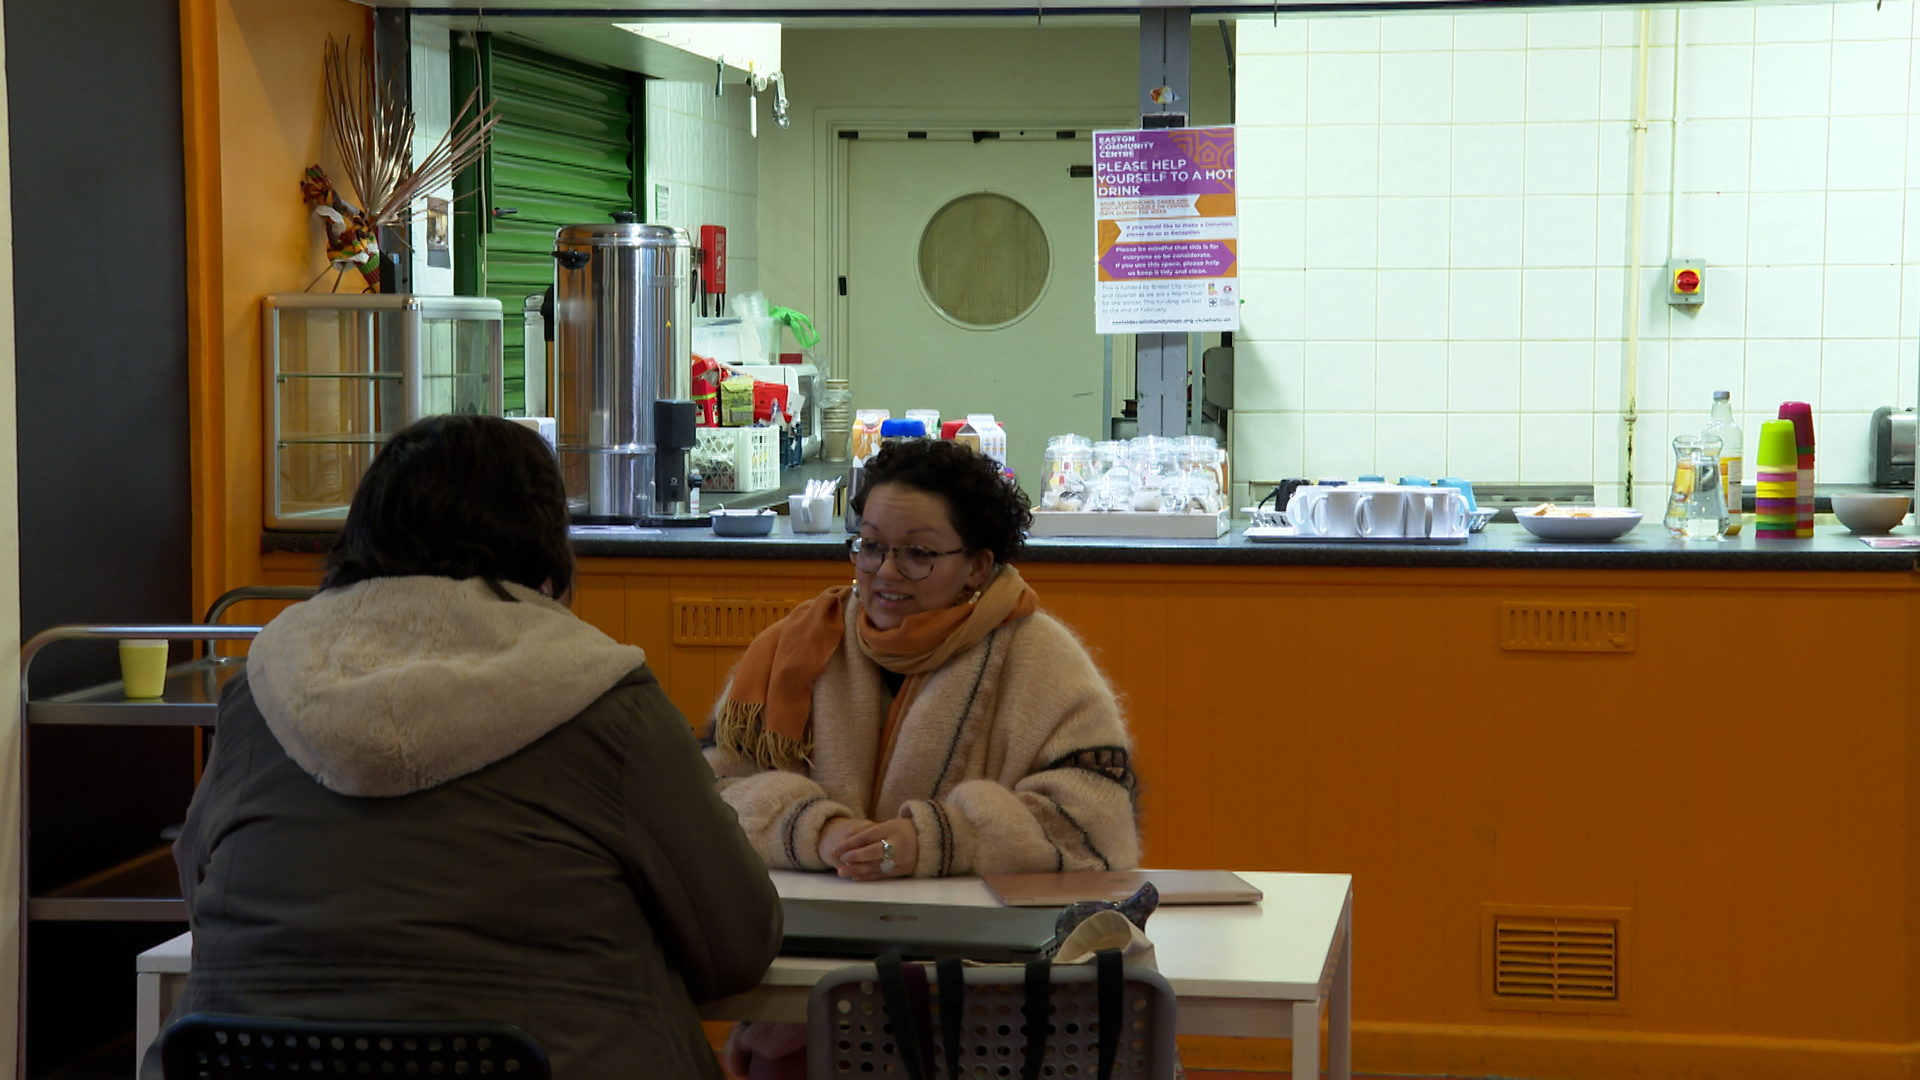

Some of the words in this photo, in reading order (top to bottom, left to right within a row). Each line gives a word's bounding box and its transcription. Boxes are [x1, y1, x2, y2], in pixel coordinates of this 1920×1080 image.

[1099, 135, 1135, 143] EASTON
[1099, 141, 1155, 150] COMMUNITY
[1099, 150, 1134, 158] CENTRE
[1097, 161, 1148, 172] PLEASE
[1152, 159, 1187, 170] HELP
[1097, 171, 1168, 184] YOURSELF
[1170, 171, 1189, 182] TO
[1192, 170, 1202, 180] A
[1205, 169, 1234, 180] HOT
[1098, 185, 1140, 196] DRINK
